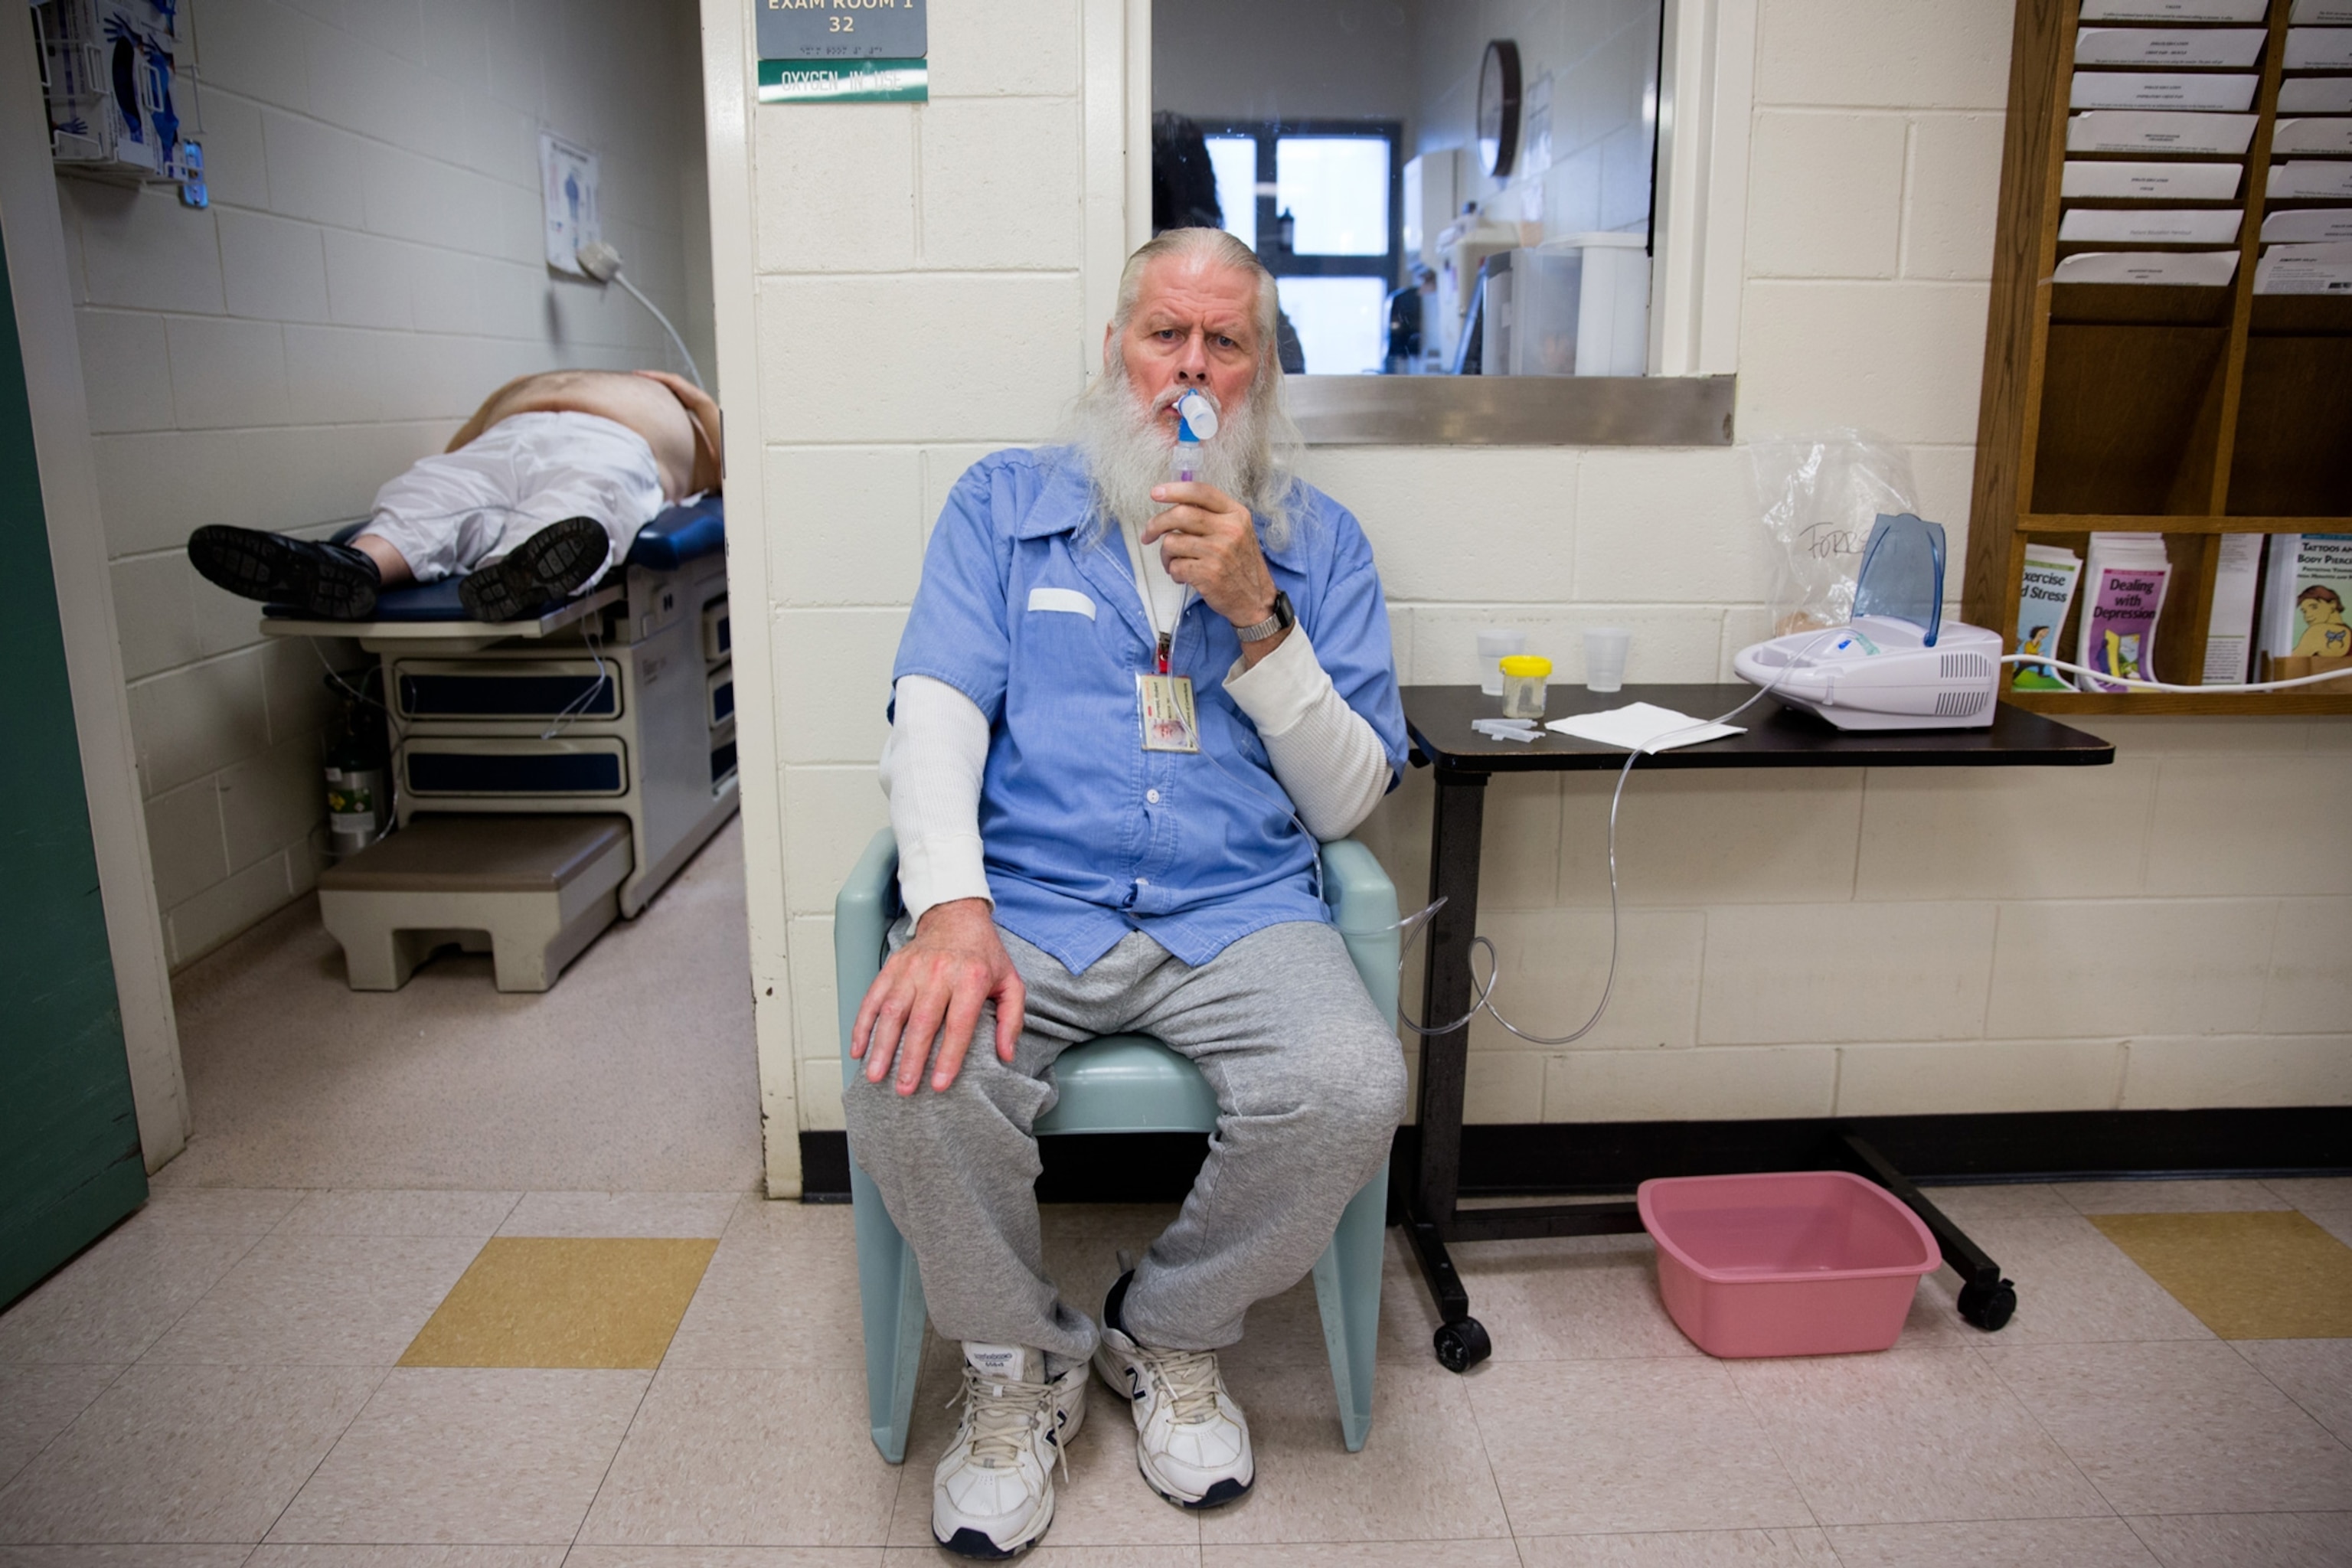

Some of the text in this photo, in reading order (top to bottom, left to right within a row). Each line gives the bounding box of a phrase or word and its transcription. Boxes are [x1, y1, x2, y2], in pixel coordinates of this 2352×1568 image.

[768, 0, 825, 9] EXAM
[833, 0, 894, 9] ROOM
[828, 16, 854, 32] 32
[781, 69, 903, 92] OXYGEN IN USE
[2022, 569, 2066, 587] xercise
[2030, 586, 2068, 603] Stress
[2109, 578, 2155, 595] Dealing
[2114, 593, 2142, 607] with
[2092, 606, 2157, 621] Depression
